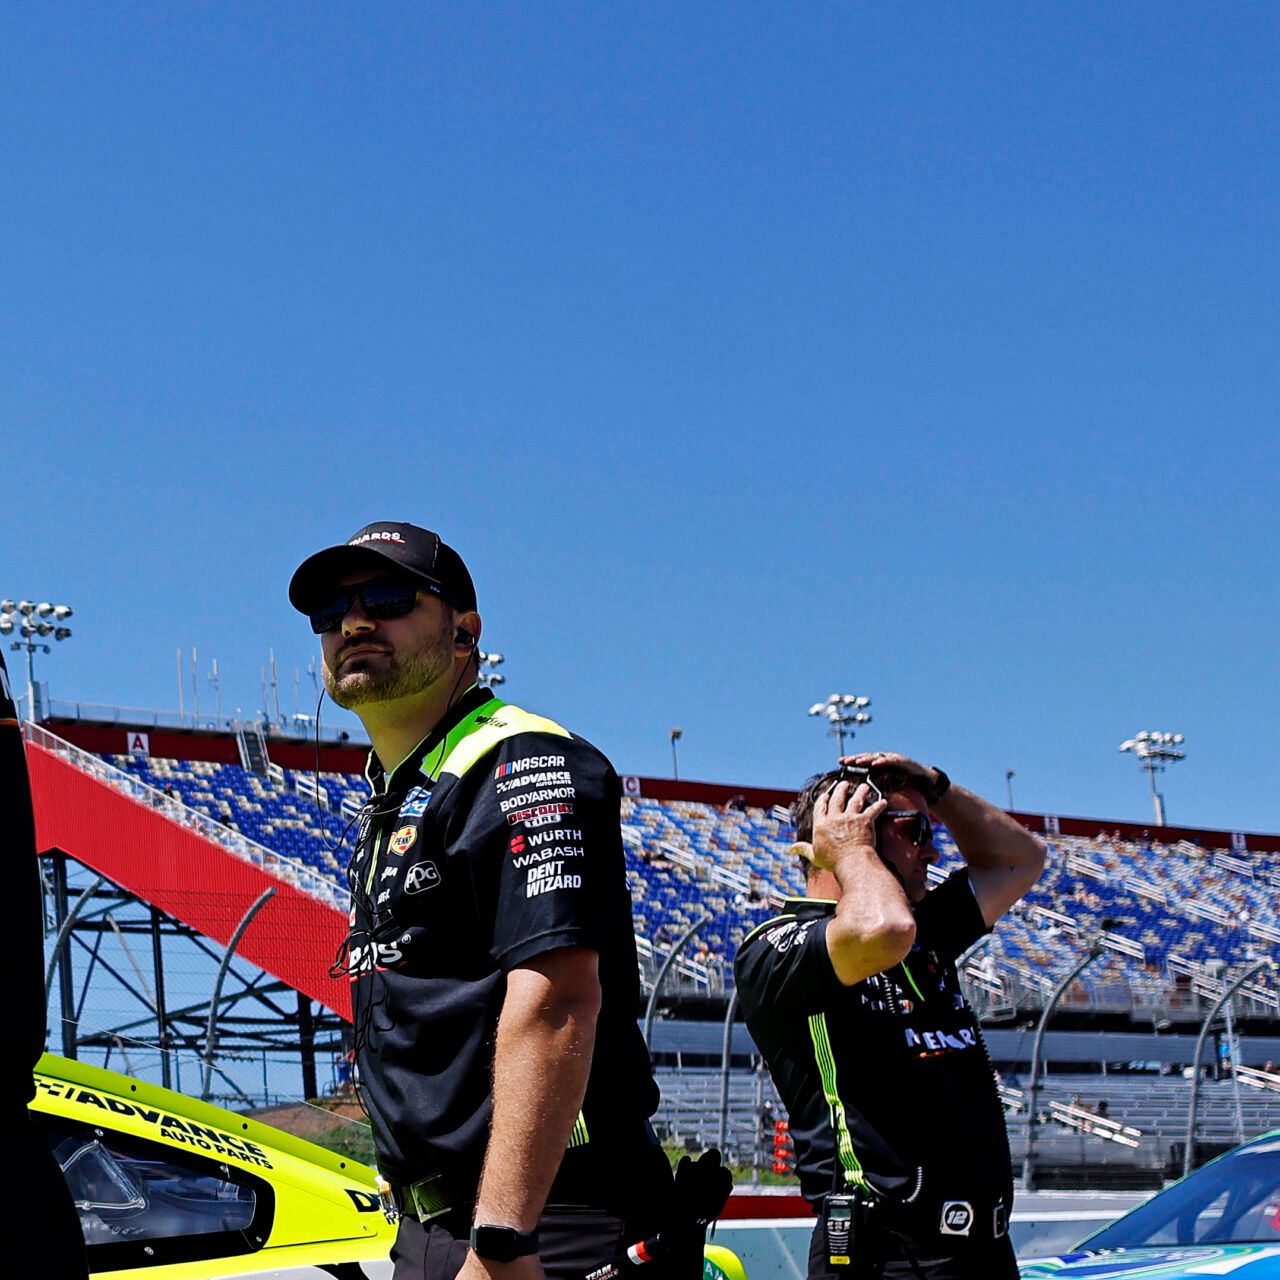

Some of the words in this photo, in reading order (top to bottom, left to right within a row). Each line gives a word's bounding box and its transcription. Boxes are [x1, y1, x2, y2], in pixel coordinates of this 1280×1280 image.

[512, 756, 565, 774] NASCAR
[511, 771, 571, 789] ADVANCE
[500, 787, 576, 812] BODYARMOR
[508, 803, 573, 824] DISCOUNT
[528, 813, 559, 827] TIRE
[528, 829, 582, 846] WÜRTH
[513, 846, 584, 868] WABASH
[527, 861, 564, 883] DENT
[527, 875, 581, 898] WIZARD
[80, 1091, 267, 1158] ADVANCE
[160, 1126, 210, 1151] AUTO
[215, 1145, 274, 1170] PARTS
[947, 1210, 968, 1225] 12
